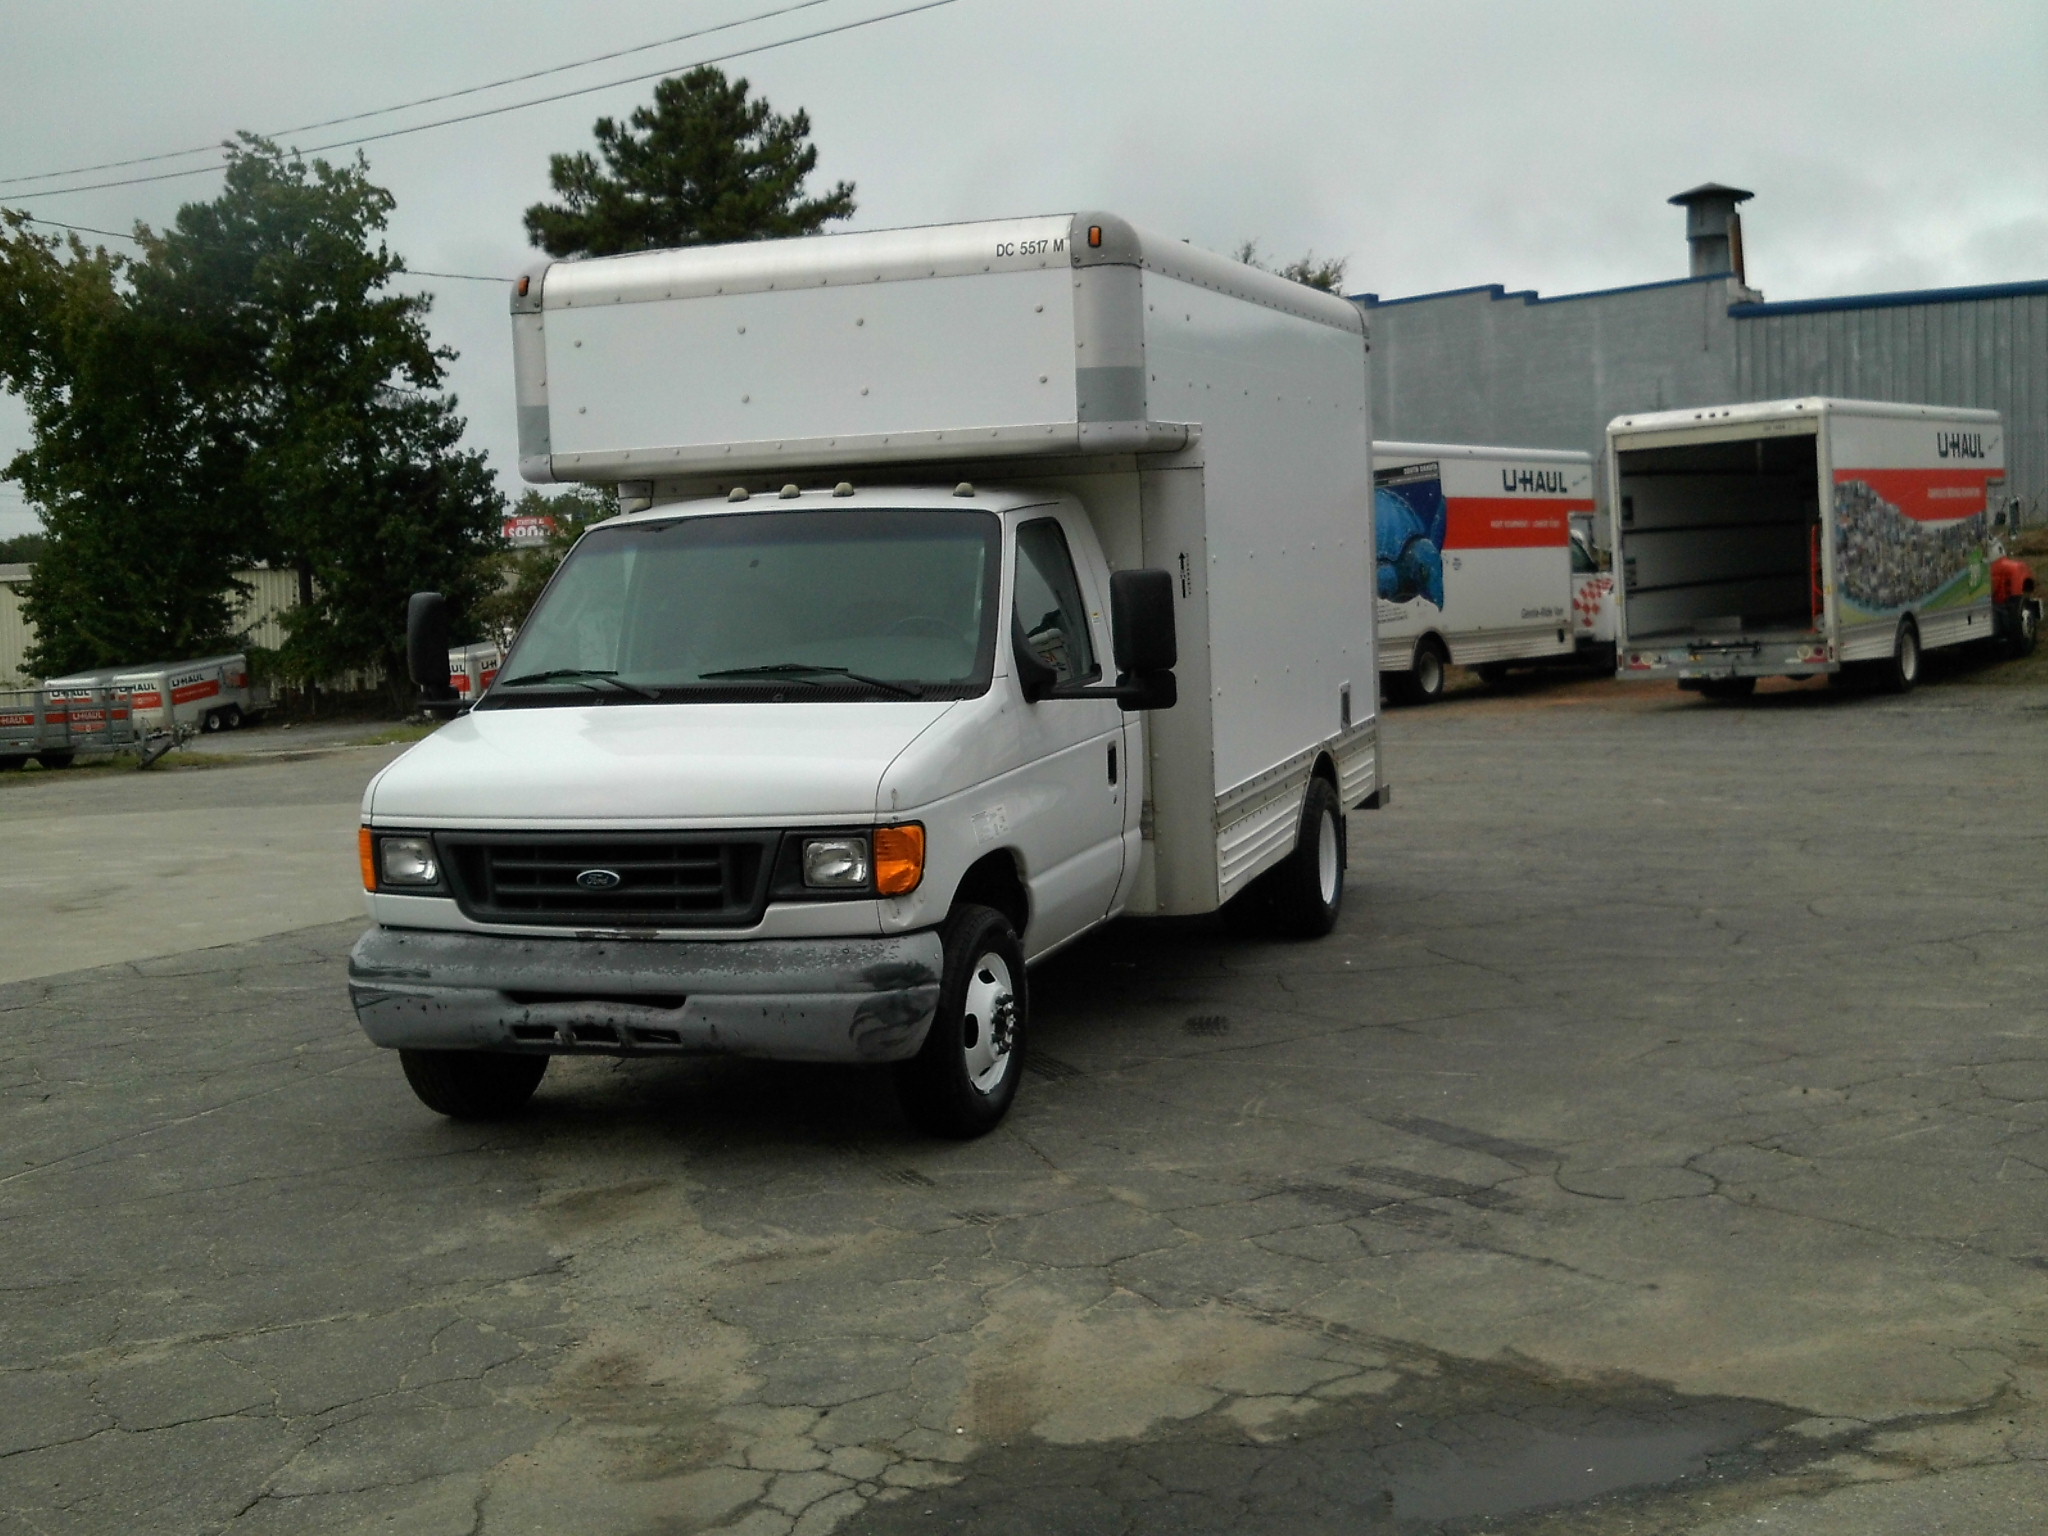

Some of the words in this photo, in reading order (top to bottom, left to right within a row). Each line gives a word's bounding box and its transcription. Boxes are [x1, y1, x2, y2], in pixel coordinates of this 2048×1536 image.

[996, 242, 1015, 258] DC
[1020, 239, 1049, 256] 5517
[1053, 238, 1064, 252] M
[1936, 432, 1985, 458] U-HAUL
[1502, 469, 1568, 493] U-HAUL
[171, 673, 204, 688] U-HAUL
